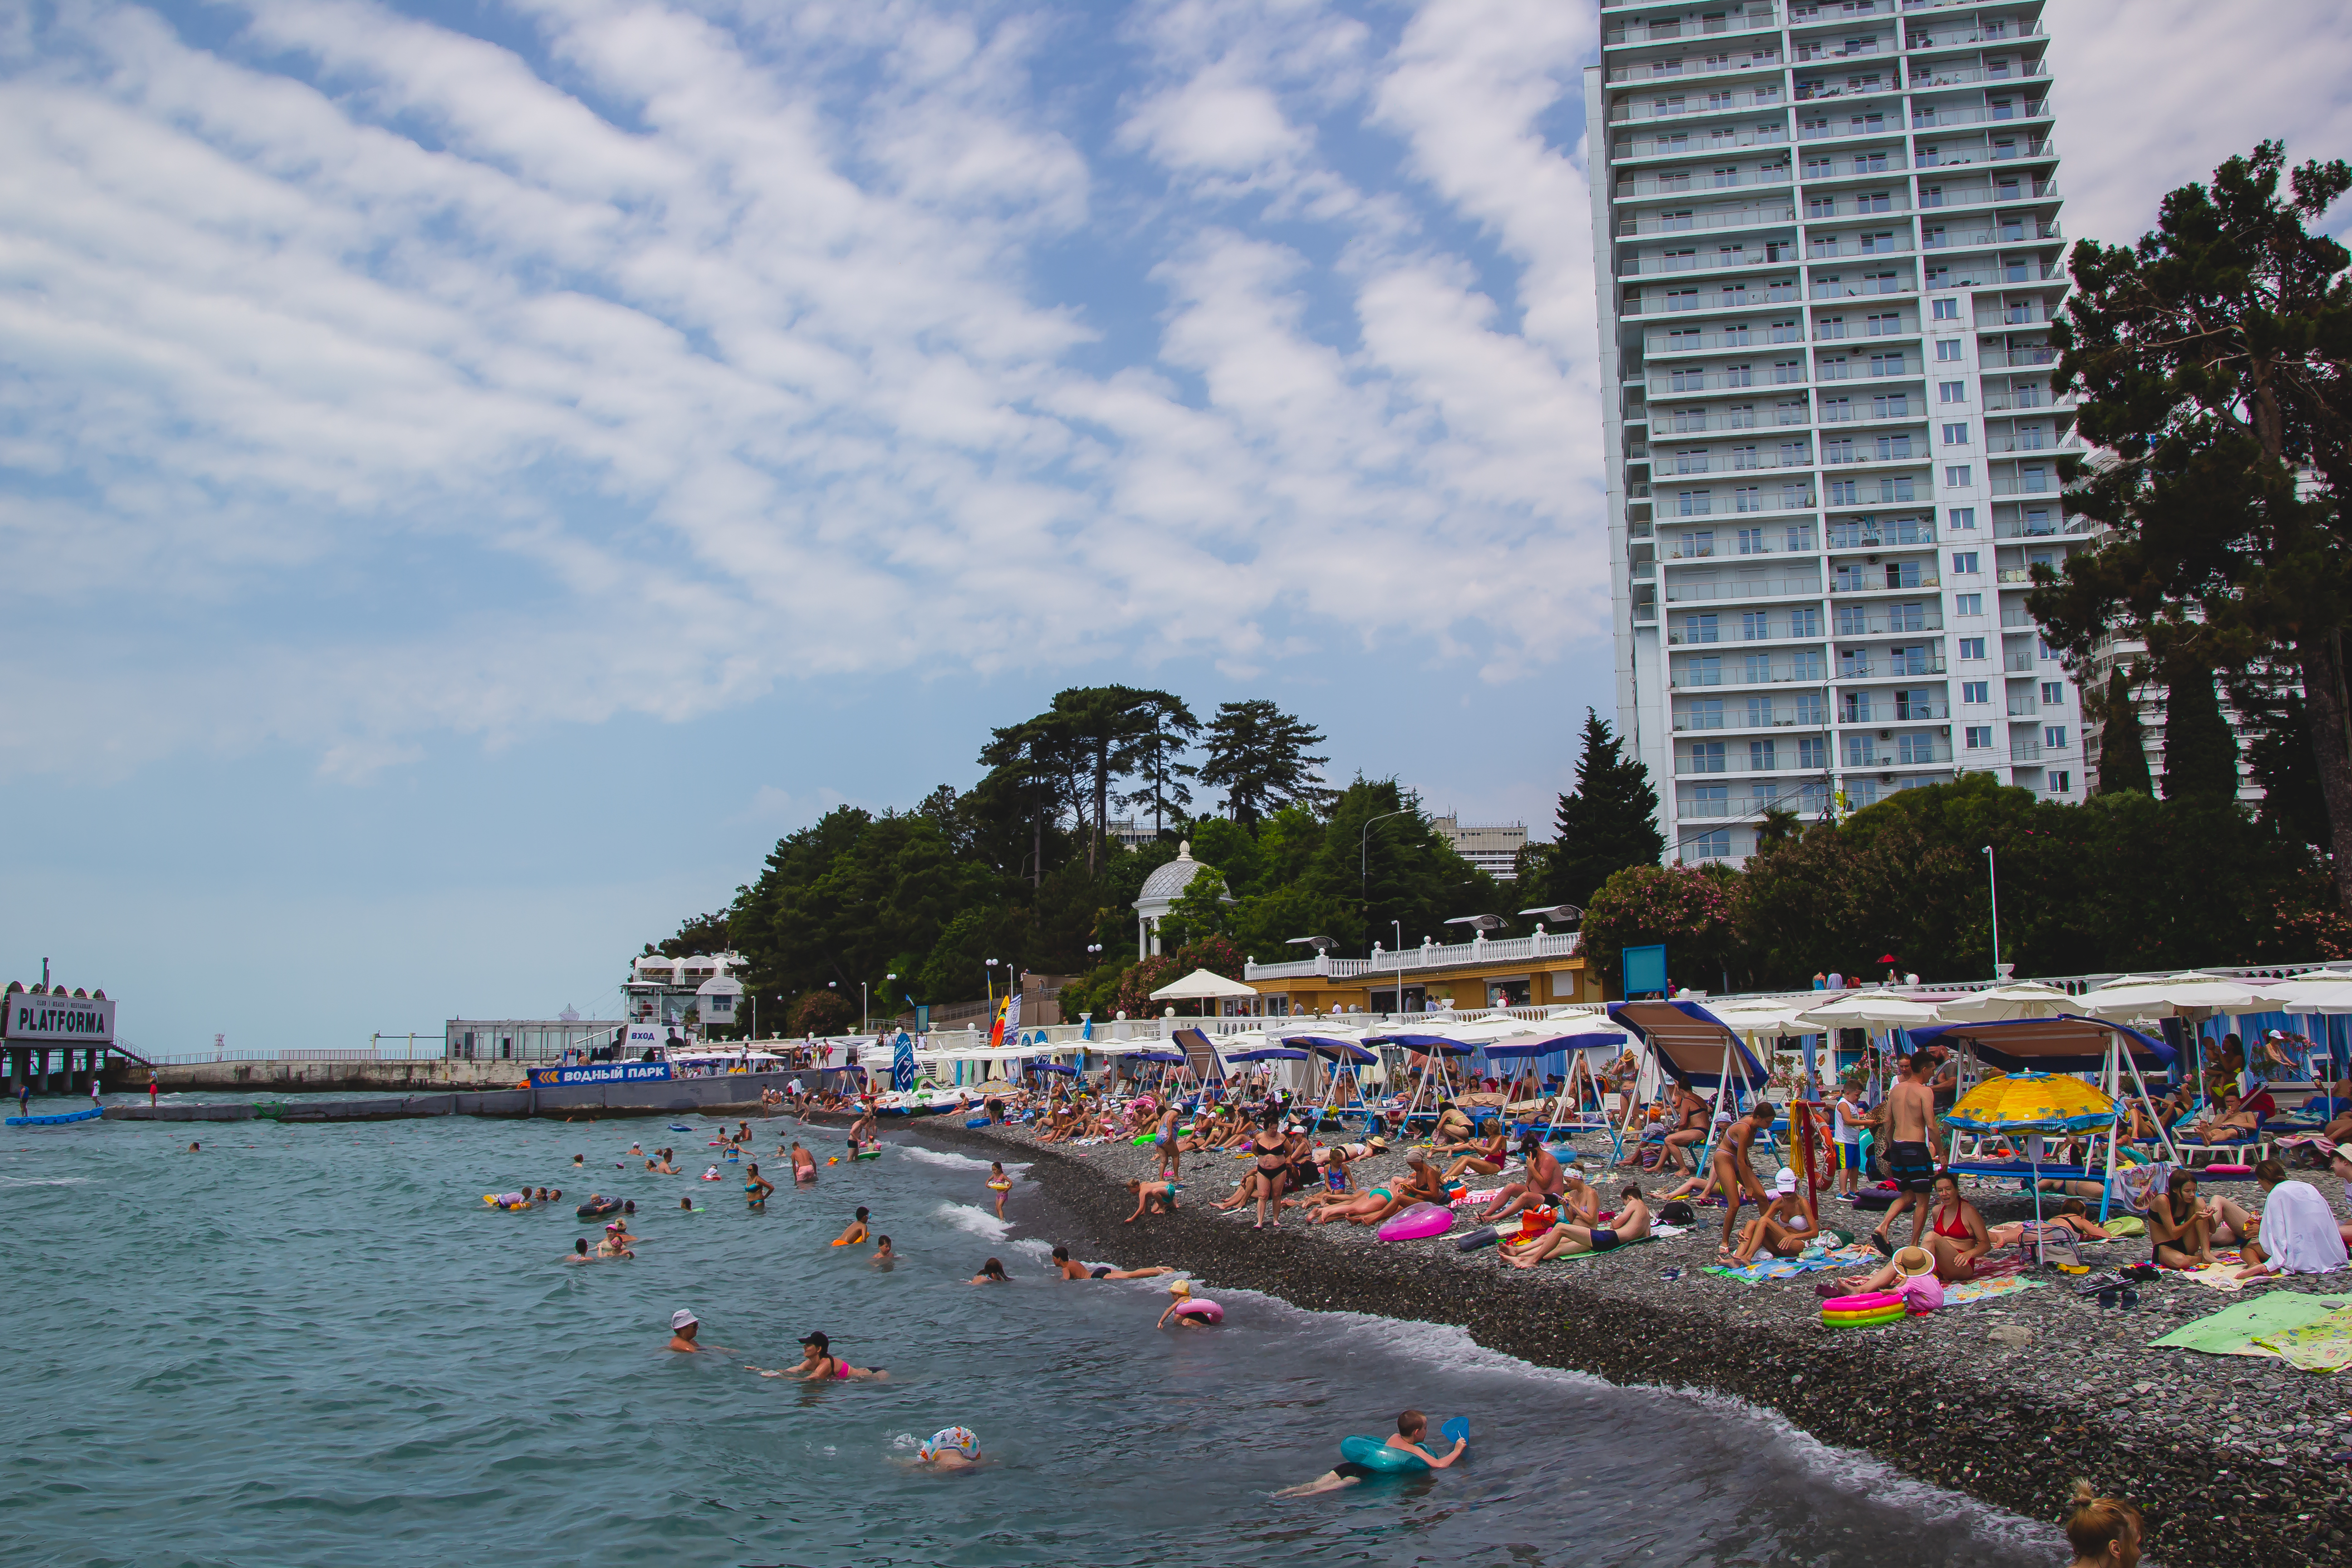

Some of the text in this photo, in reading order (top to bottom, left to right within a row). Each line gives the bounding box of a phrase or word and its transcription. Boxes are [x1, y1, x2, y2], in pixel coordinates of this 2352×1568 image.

[19, 1007, 105, 1033] PLATFORMA
[631, 1032, 655, 1040] ВХОД
[564, 1066, 665, 1082] ВОДНЫЙ ПАРК
